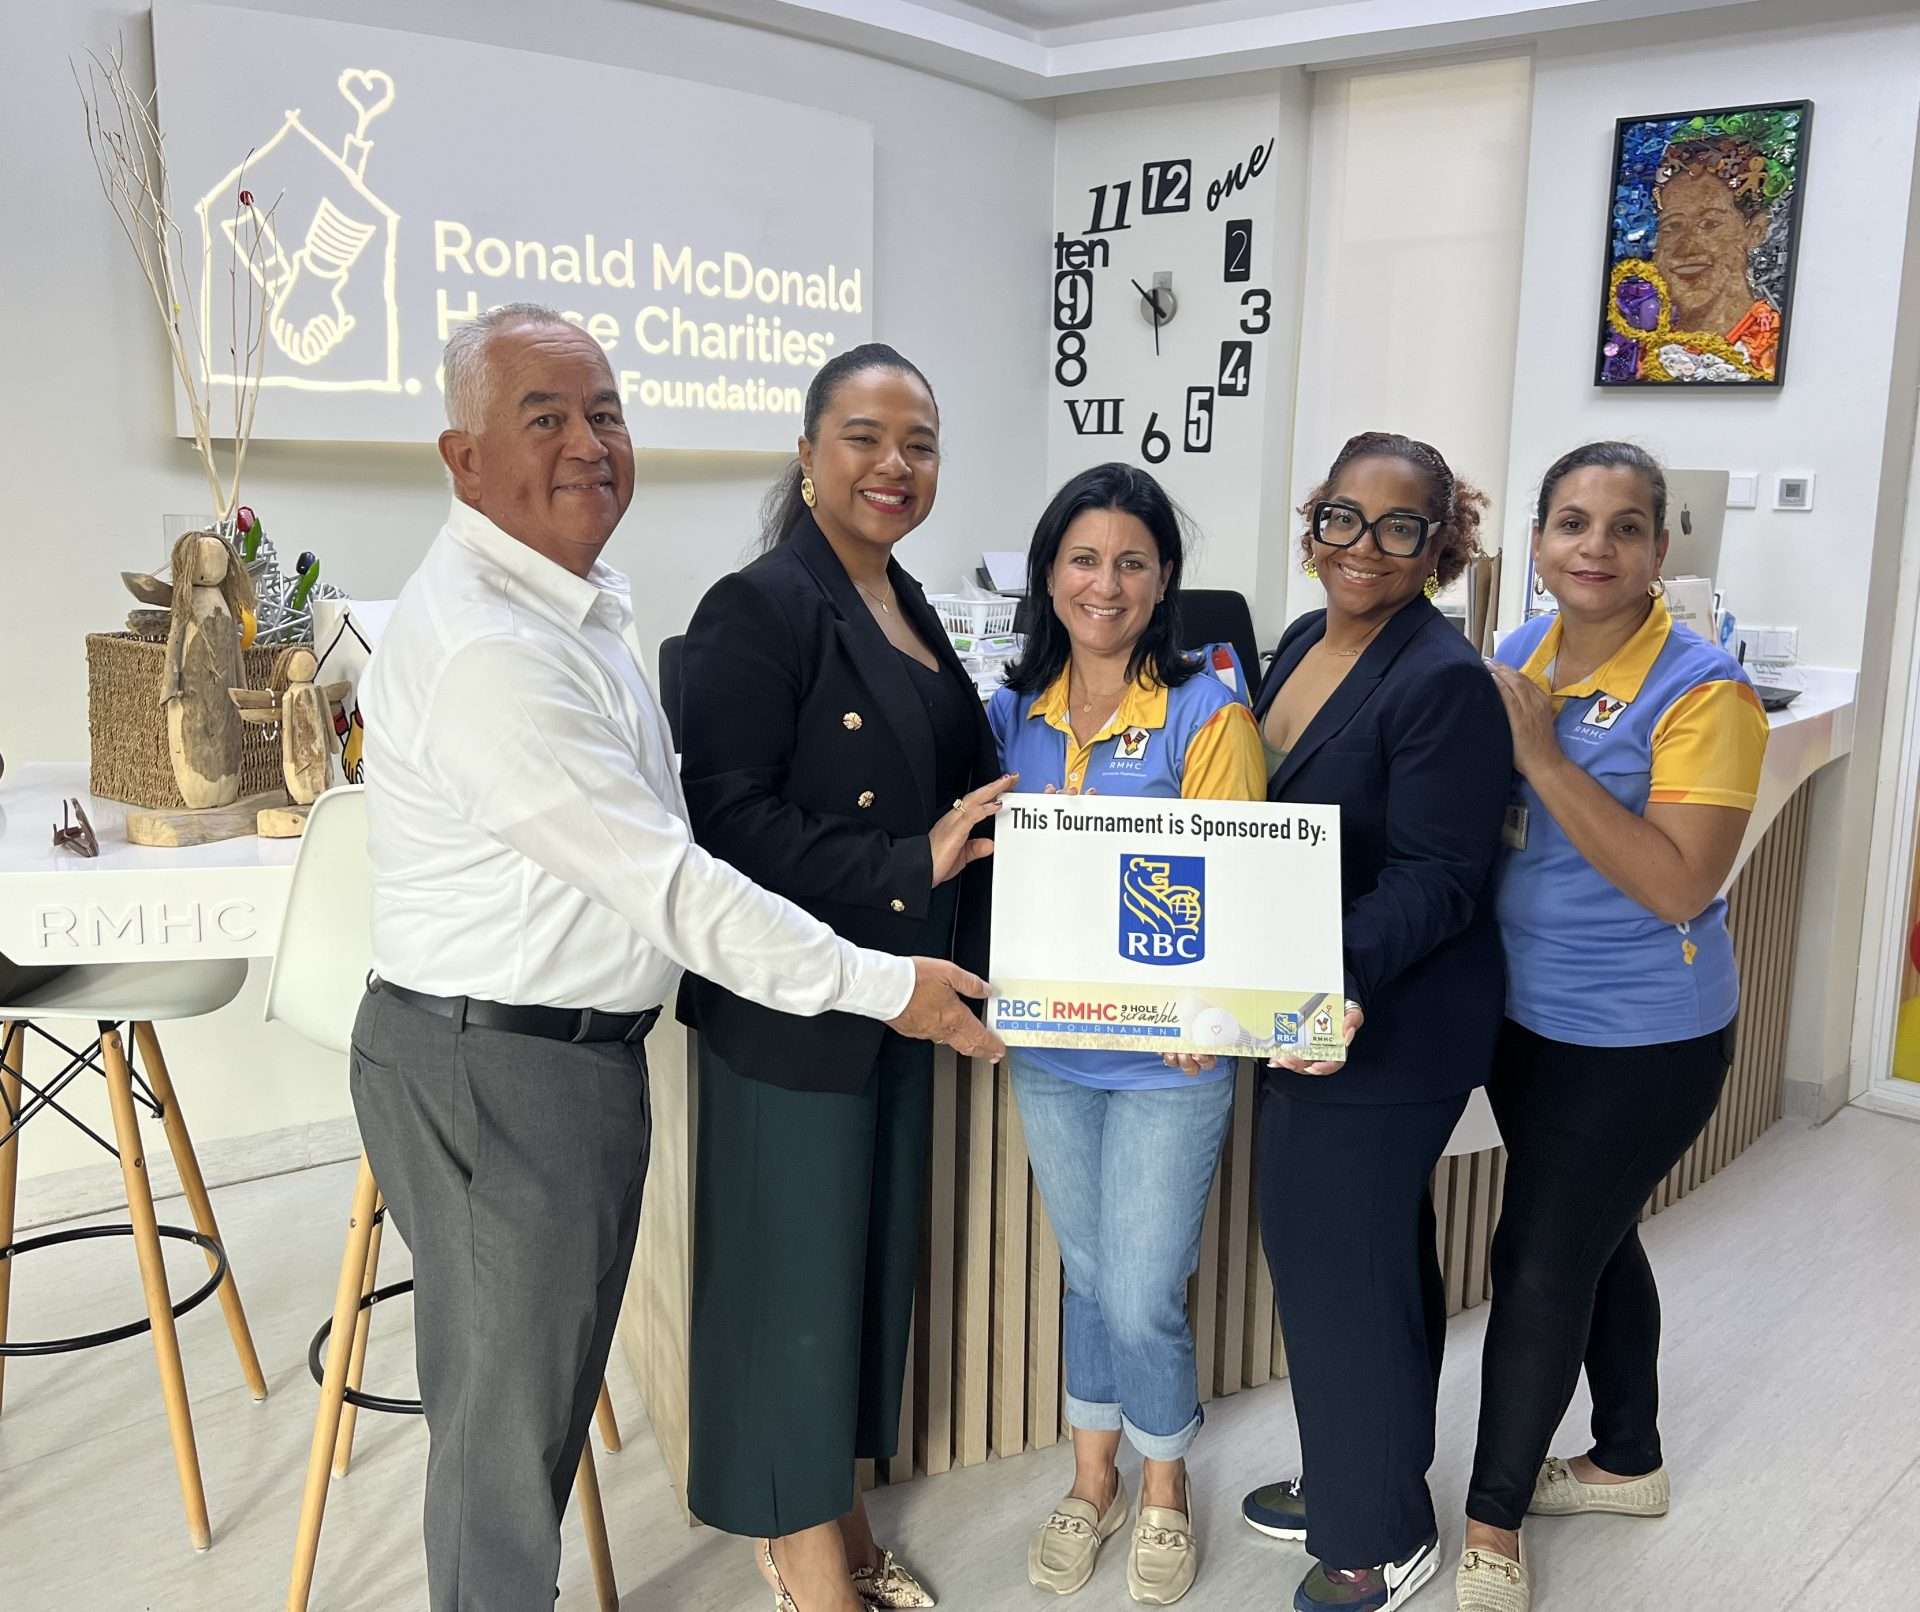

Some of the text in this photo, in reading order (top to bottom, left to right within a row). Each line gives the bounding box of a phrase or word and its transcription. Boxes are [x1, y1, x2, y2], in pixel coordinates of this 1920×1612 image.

[1147, 163, 1190, 209] 12
[1206, 137, 1275, 212] one
[1082, 180, 1132, 236] 11
[434, 219, 863, 314] Ronald McDonald
[1054, 231, 1110, 270] ten
[1229, 229, 1248, 273] 2
[1058, 272, 1091, 326] 9
[1239, 288, 1272, 335] 3
[1055, 329, 1088, 388] 8
[1220, 346, 1248, 392] 4
[619, 369, 802, 415] Foundation
[1063, 398, 1125, 435] VII
[1141, 411, 1171, 464] 6
[1187, 391, 1211, 449] 5
[1574, 725, 1607, 740] RMHC
[1109, 761, 1143, 770] RMHC
[1010, 807, 1327, 847] This Tournament is Sponsored By:
[34, 900, 257, 948] RMHC
[1127, 931, 1198, 959] RBC
[996, 999, 1118, 1021] RBC RMHC
[999, 1021, 1179, 1036] GOLF TOURNAMENT
[1120, 1004, 1158, 1014] 9 HOLE
[1120, 1001, 1181, 1024] scramble
[1276, 1034, 1297, 1042] RBC
